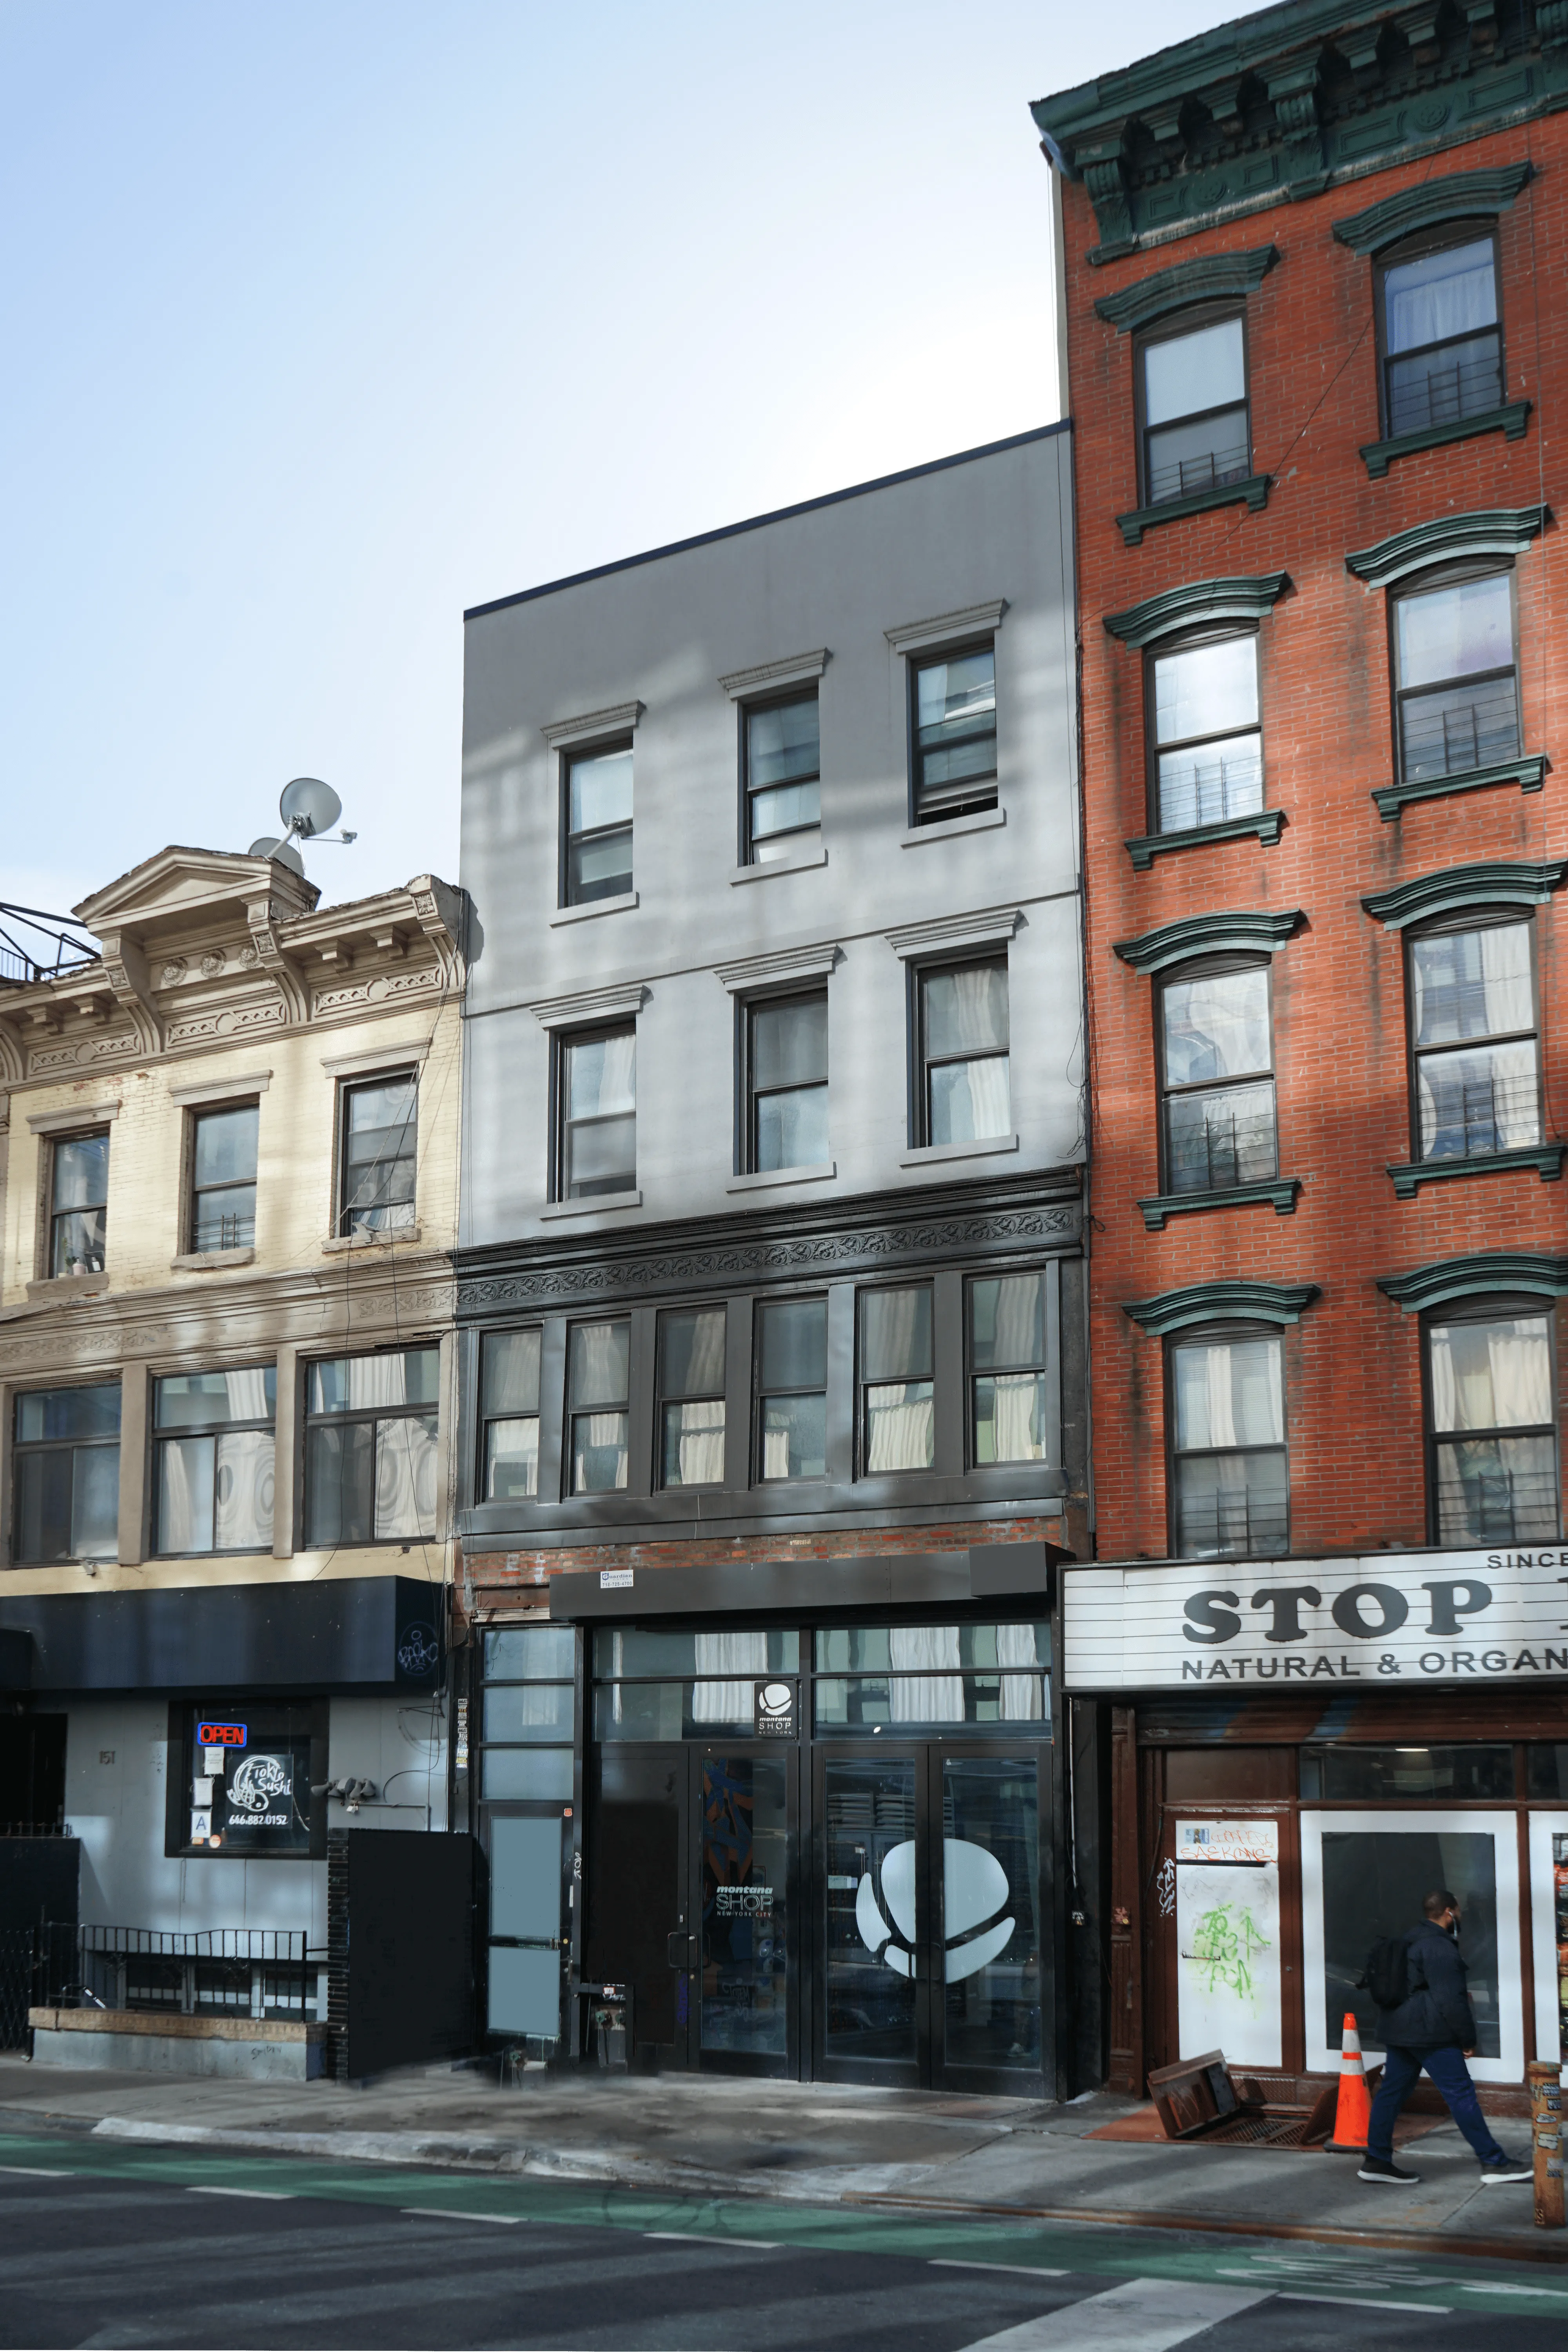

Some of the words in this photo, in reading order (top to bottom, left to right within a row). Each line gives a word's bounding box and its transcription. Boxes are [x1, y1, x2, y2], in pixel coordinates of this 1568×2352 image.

[1182, 1579, 1492, 1644] STOP
[1182, 1655, 1360, 1680] NATURAL
[1377, 1653, 1401, 1675] &
[200, 1725, 244, 1744] OPEN
[99, 1750, 116, 1765] 151
[256, 1779, 292, 1796] Sushi
[196, 1815, 207, 1830] A
[229, 1815, 289, 1826] 646.882.0152
[717, 1886, 773, 1894] montana
[716, 1893, 774, 1911] SHOP
